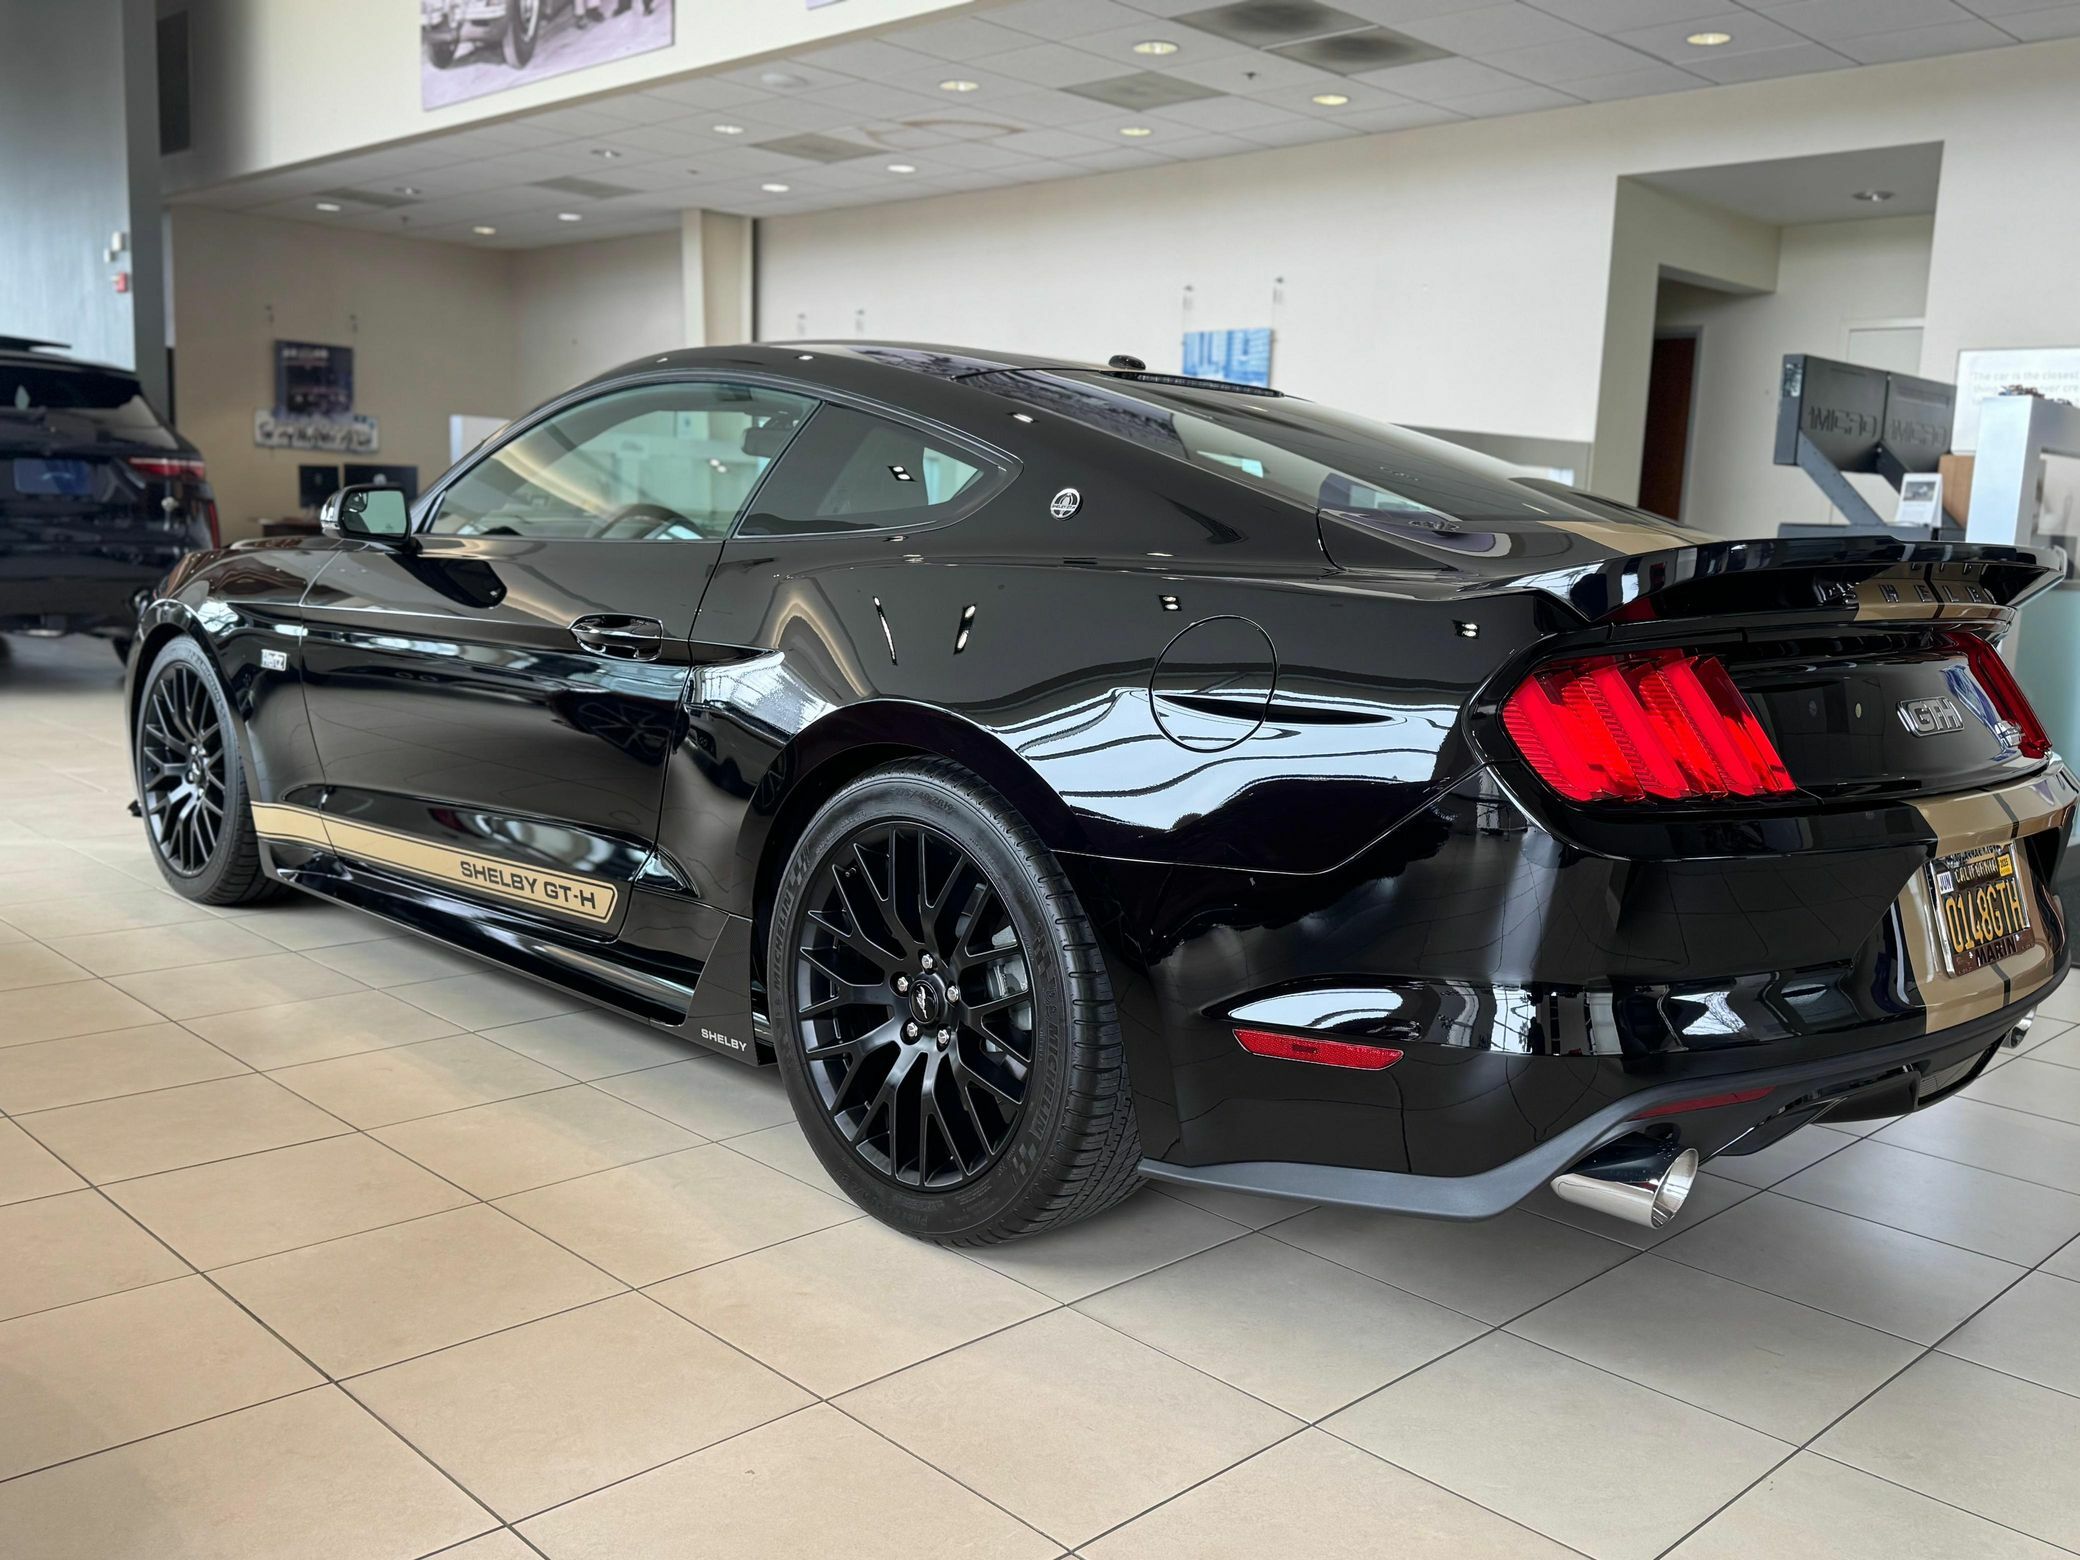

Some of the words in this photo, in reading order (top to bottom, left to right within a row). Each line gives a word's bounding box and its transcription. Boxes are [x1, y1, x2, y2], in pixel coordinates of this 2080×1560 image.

[460, 860, 538, 894] SHELBY
[543, 881, 597, 909] GT-H
[773, 890, 795, 992] MICHELIN
[1975, 934, 2018, 966] MARIN
[701, 1027, 747, 1052] SHELBY
[1033, 1023, 1060, 1138] MICHELIN
